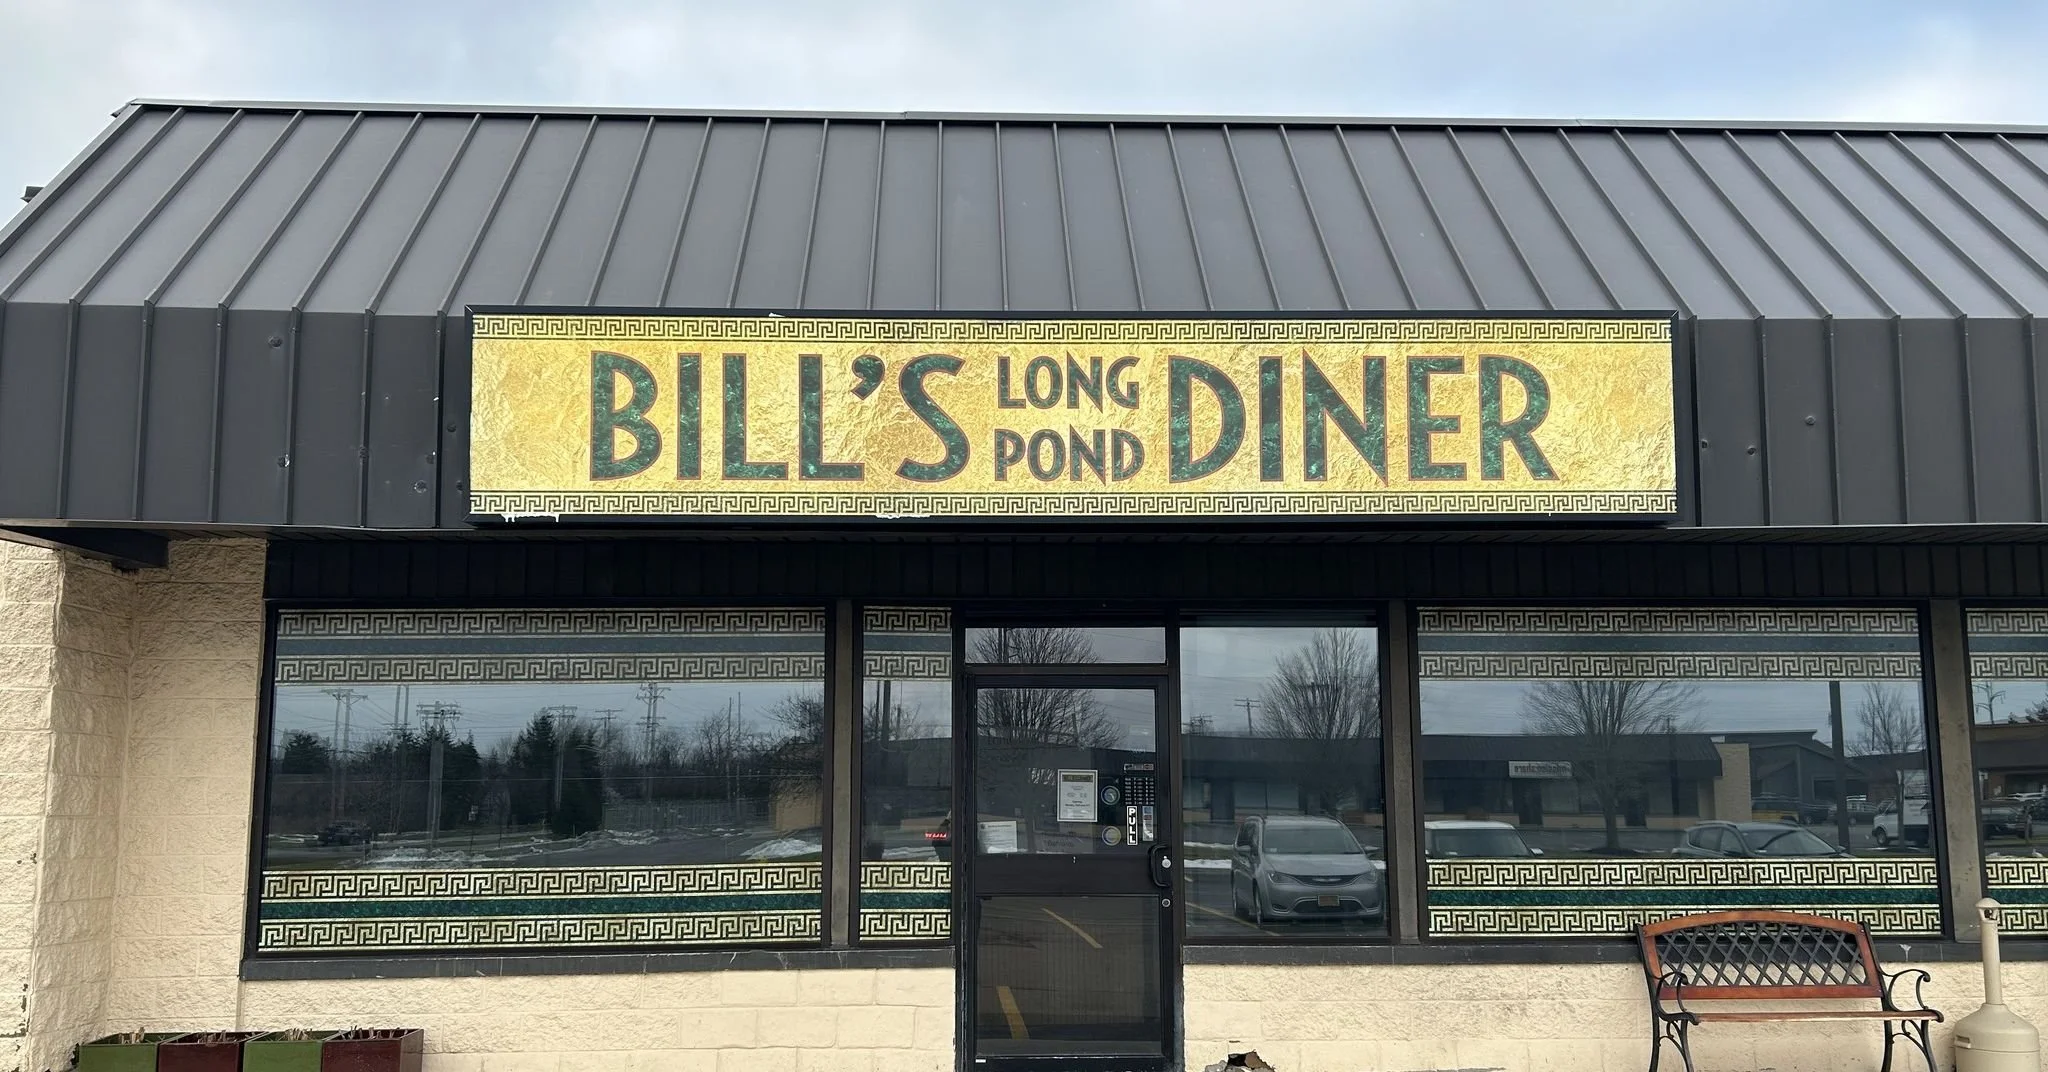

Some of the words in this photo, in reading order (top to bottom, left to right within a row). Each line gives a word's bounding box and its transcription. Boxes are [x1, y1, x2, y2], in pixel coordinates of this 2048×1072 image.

[997, 351, 1141, 414] LONG
[590, 350, 971, 483] BILL'S
[1168, 347, 1561, 487] DINER
[994, 425, 1145, 486] POND
[1128, 807, 1136, 844] PULL
